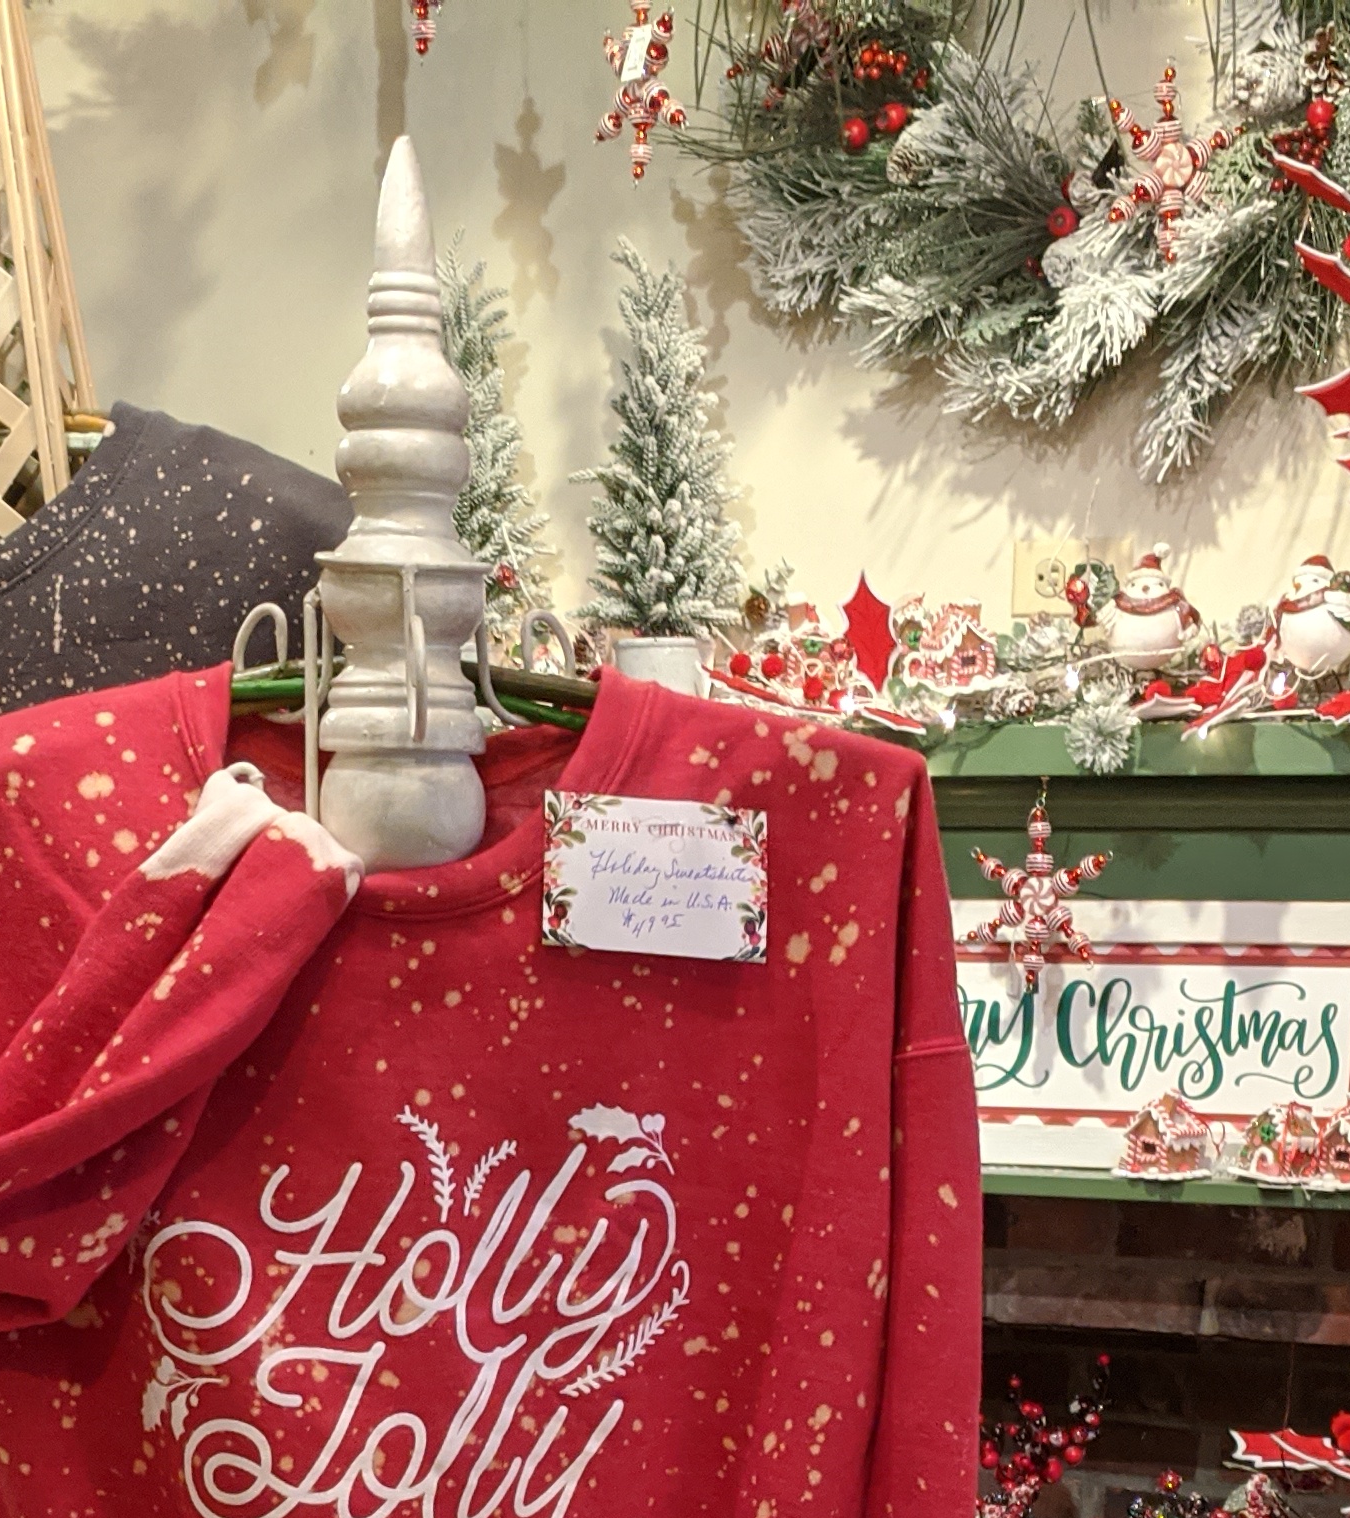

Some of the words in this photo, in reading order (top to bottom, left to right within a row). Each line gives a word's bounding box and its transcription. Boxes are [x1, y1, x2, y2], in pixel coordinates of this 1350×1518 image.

[584, 817, 642, 835] MERRY
[646, 821, 739, 843] CHRISTMAS
[588, 849, 662, 890] Holiday
[608, 884, 653, 906] Made
[1055, 977, 1341, 1100] Christmas
[144, 1143, 676, 1380] Holly
